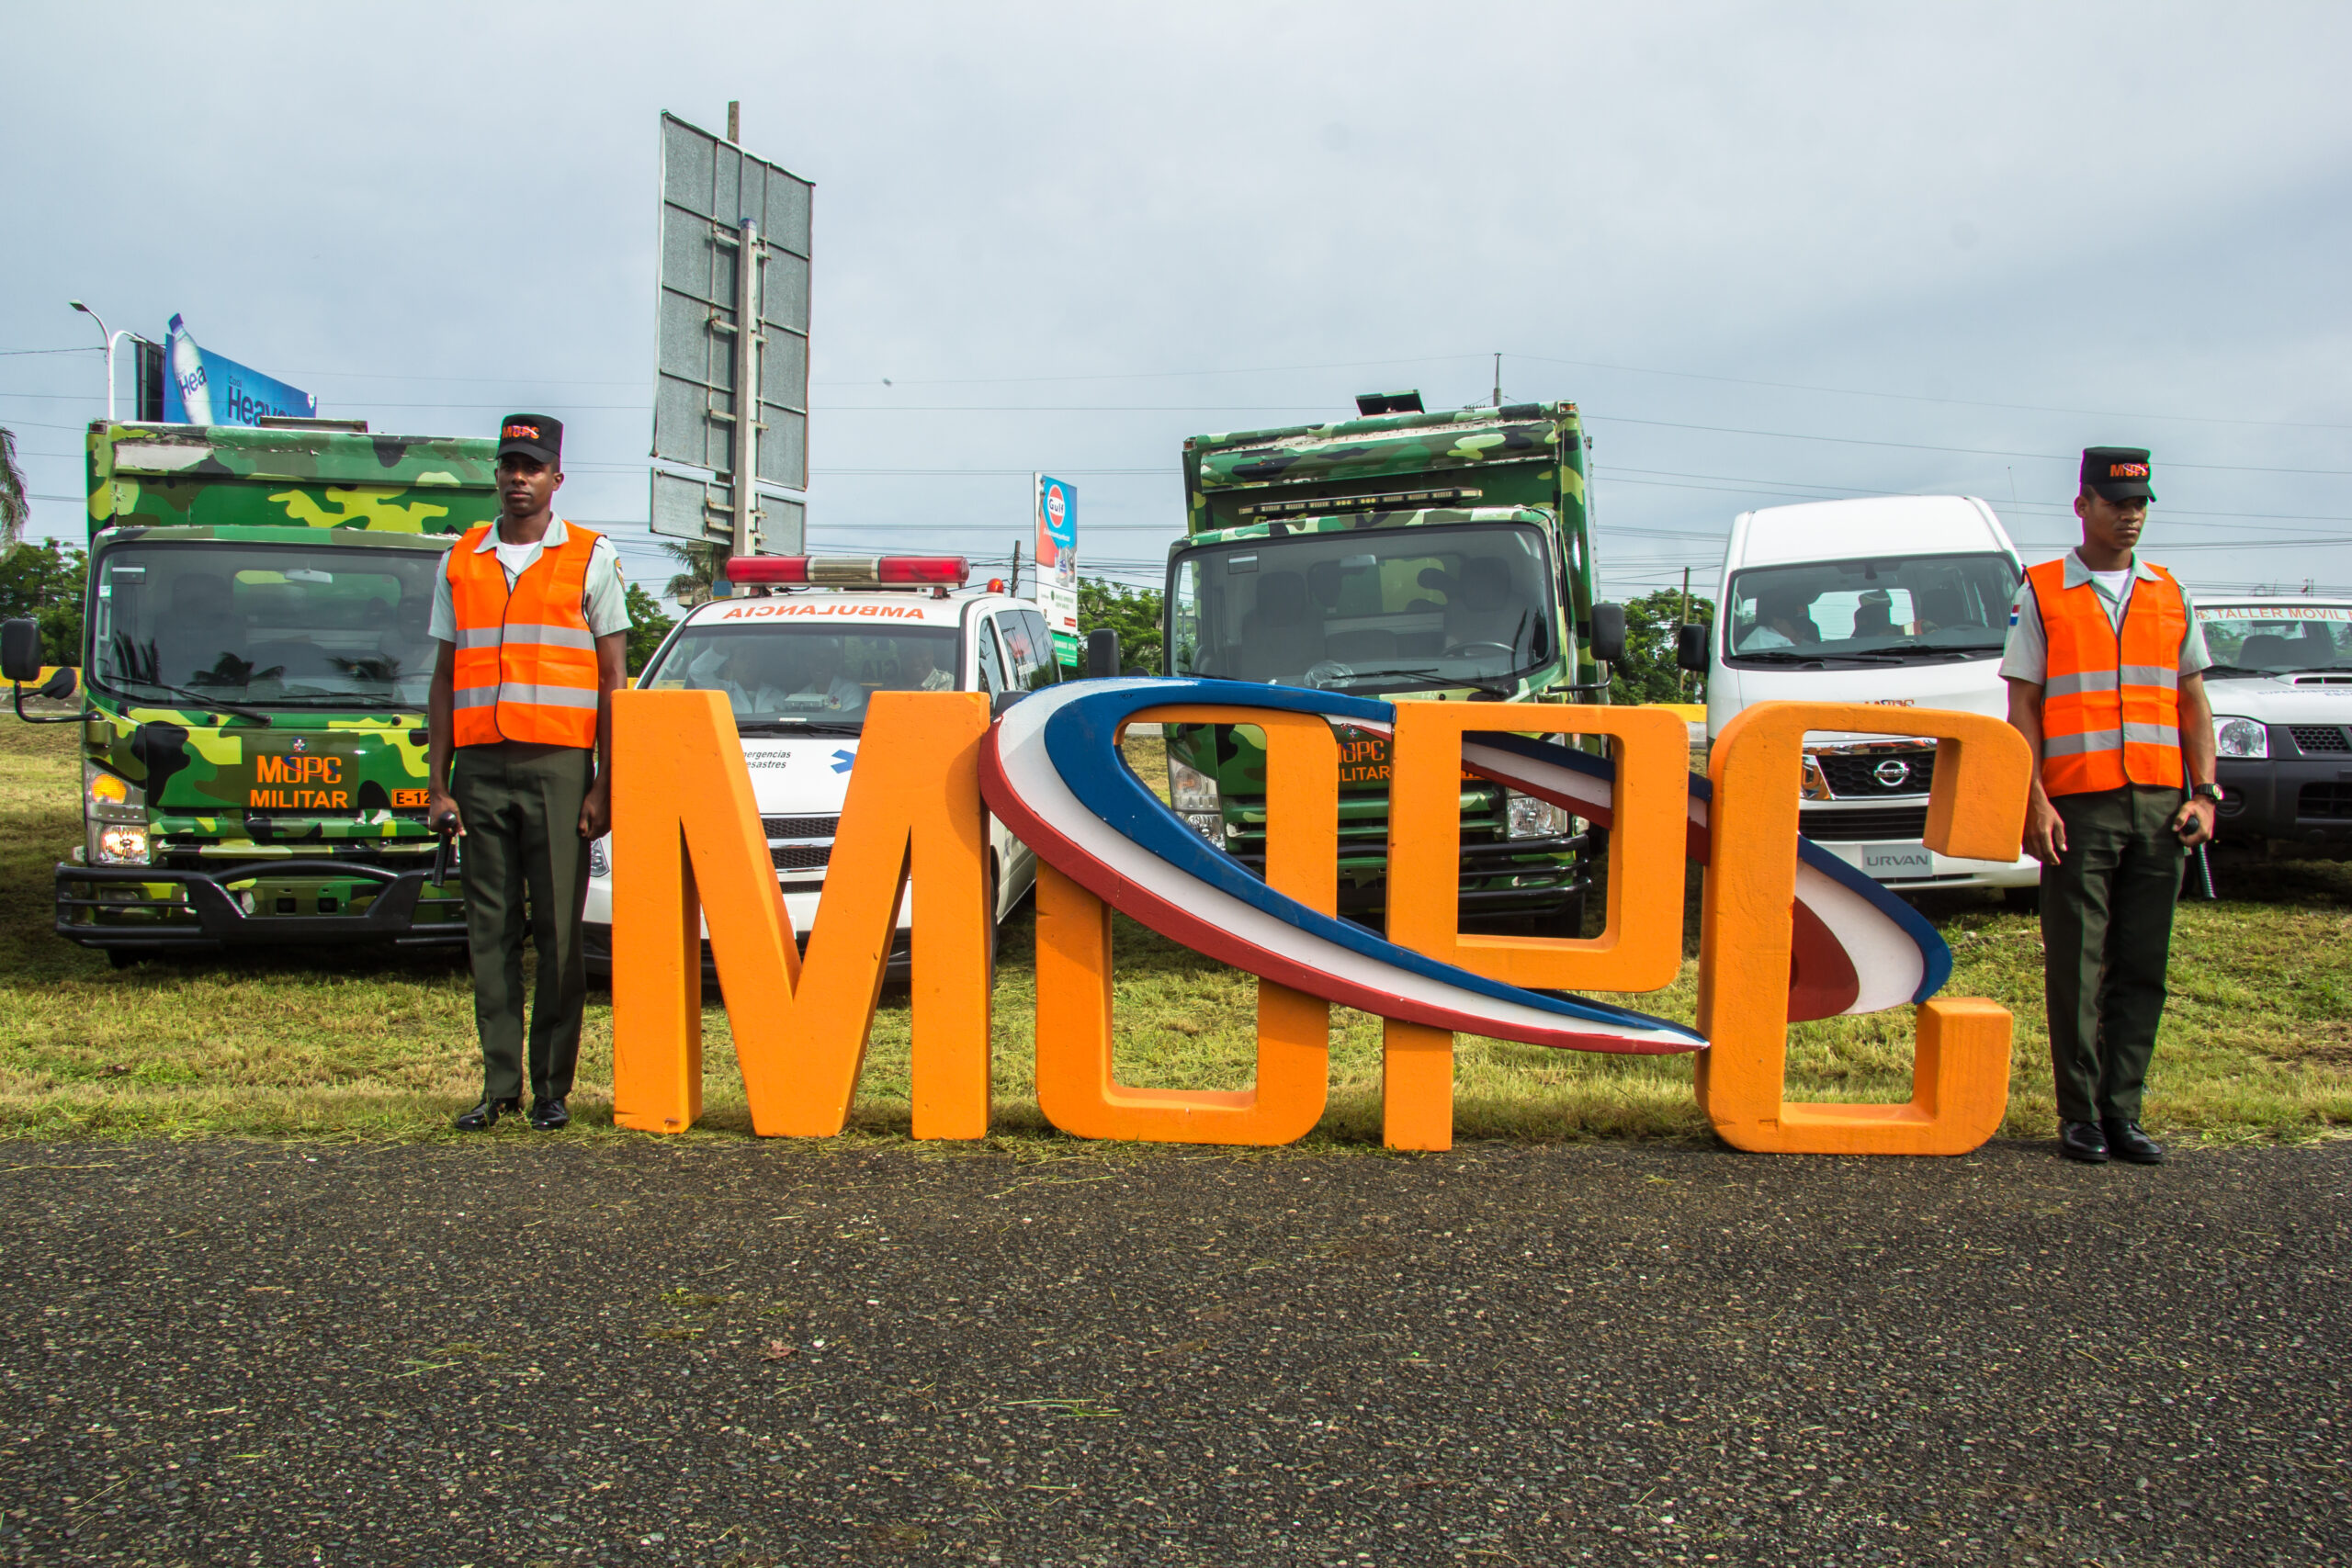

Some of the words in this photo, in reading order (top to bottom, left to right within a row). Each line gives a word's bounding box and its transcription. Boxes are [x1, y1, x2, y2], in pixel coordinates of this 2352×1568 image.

[229, 375, 243, 388] Cool
[1048, 498, 1064, 513] Gulf
[2214, 607, 2282, 619] TALLER
[2288, 608, 2346, 621] MOVIL
[256, 755, 342, 784] MOPC
[746, 761, 786, 769] esastres
[1338, 766, 1390, 782] ILITAR
[250, 789, 348, 808] MILITAR
[1867, 855, 1928, 866] URVAN
[612, 689, 2033, 1156] MOPC
